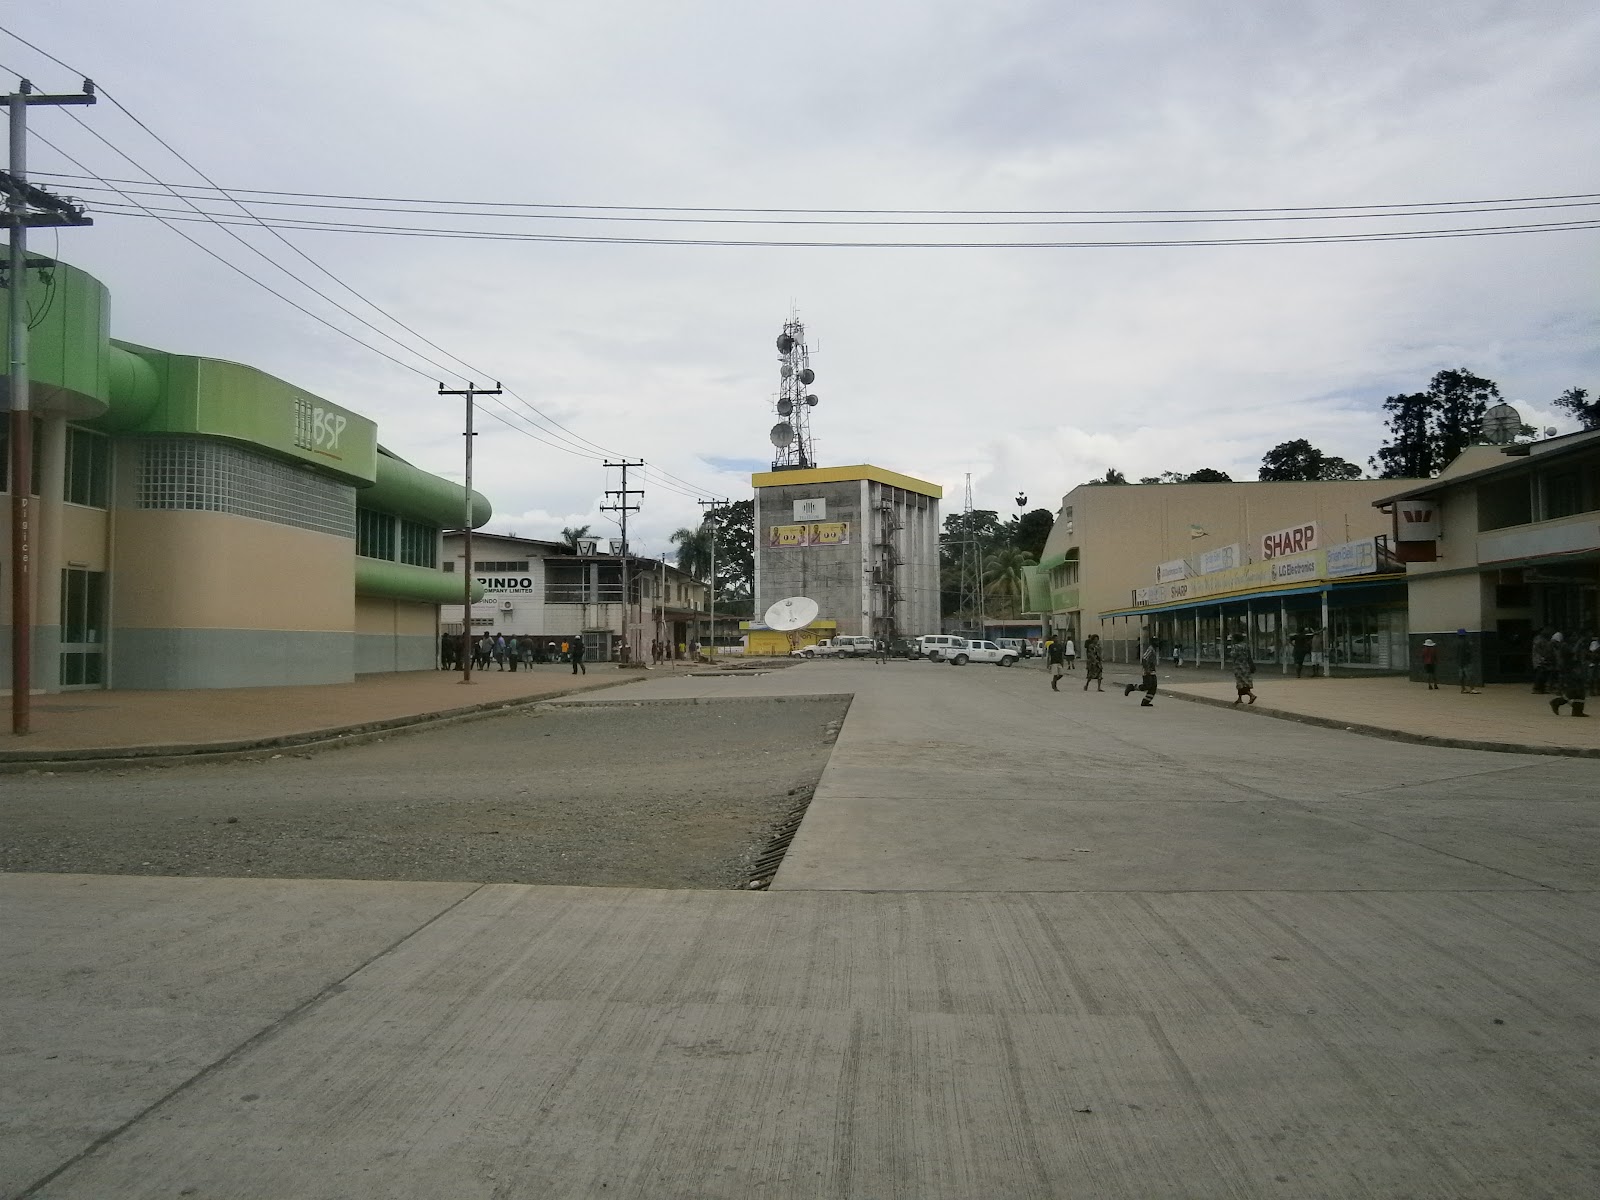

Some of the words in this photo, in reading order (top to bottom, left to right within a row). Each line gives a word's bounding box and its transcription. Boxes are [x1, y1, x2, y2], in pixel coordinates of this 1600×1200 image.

[312, 407, 347, 449] BSP
[1263, 525, 1315, 560] SHARP
[1278, 564, 1286, 577] LG
[1171, 585, 1188, 598] SHARP
